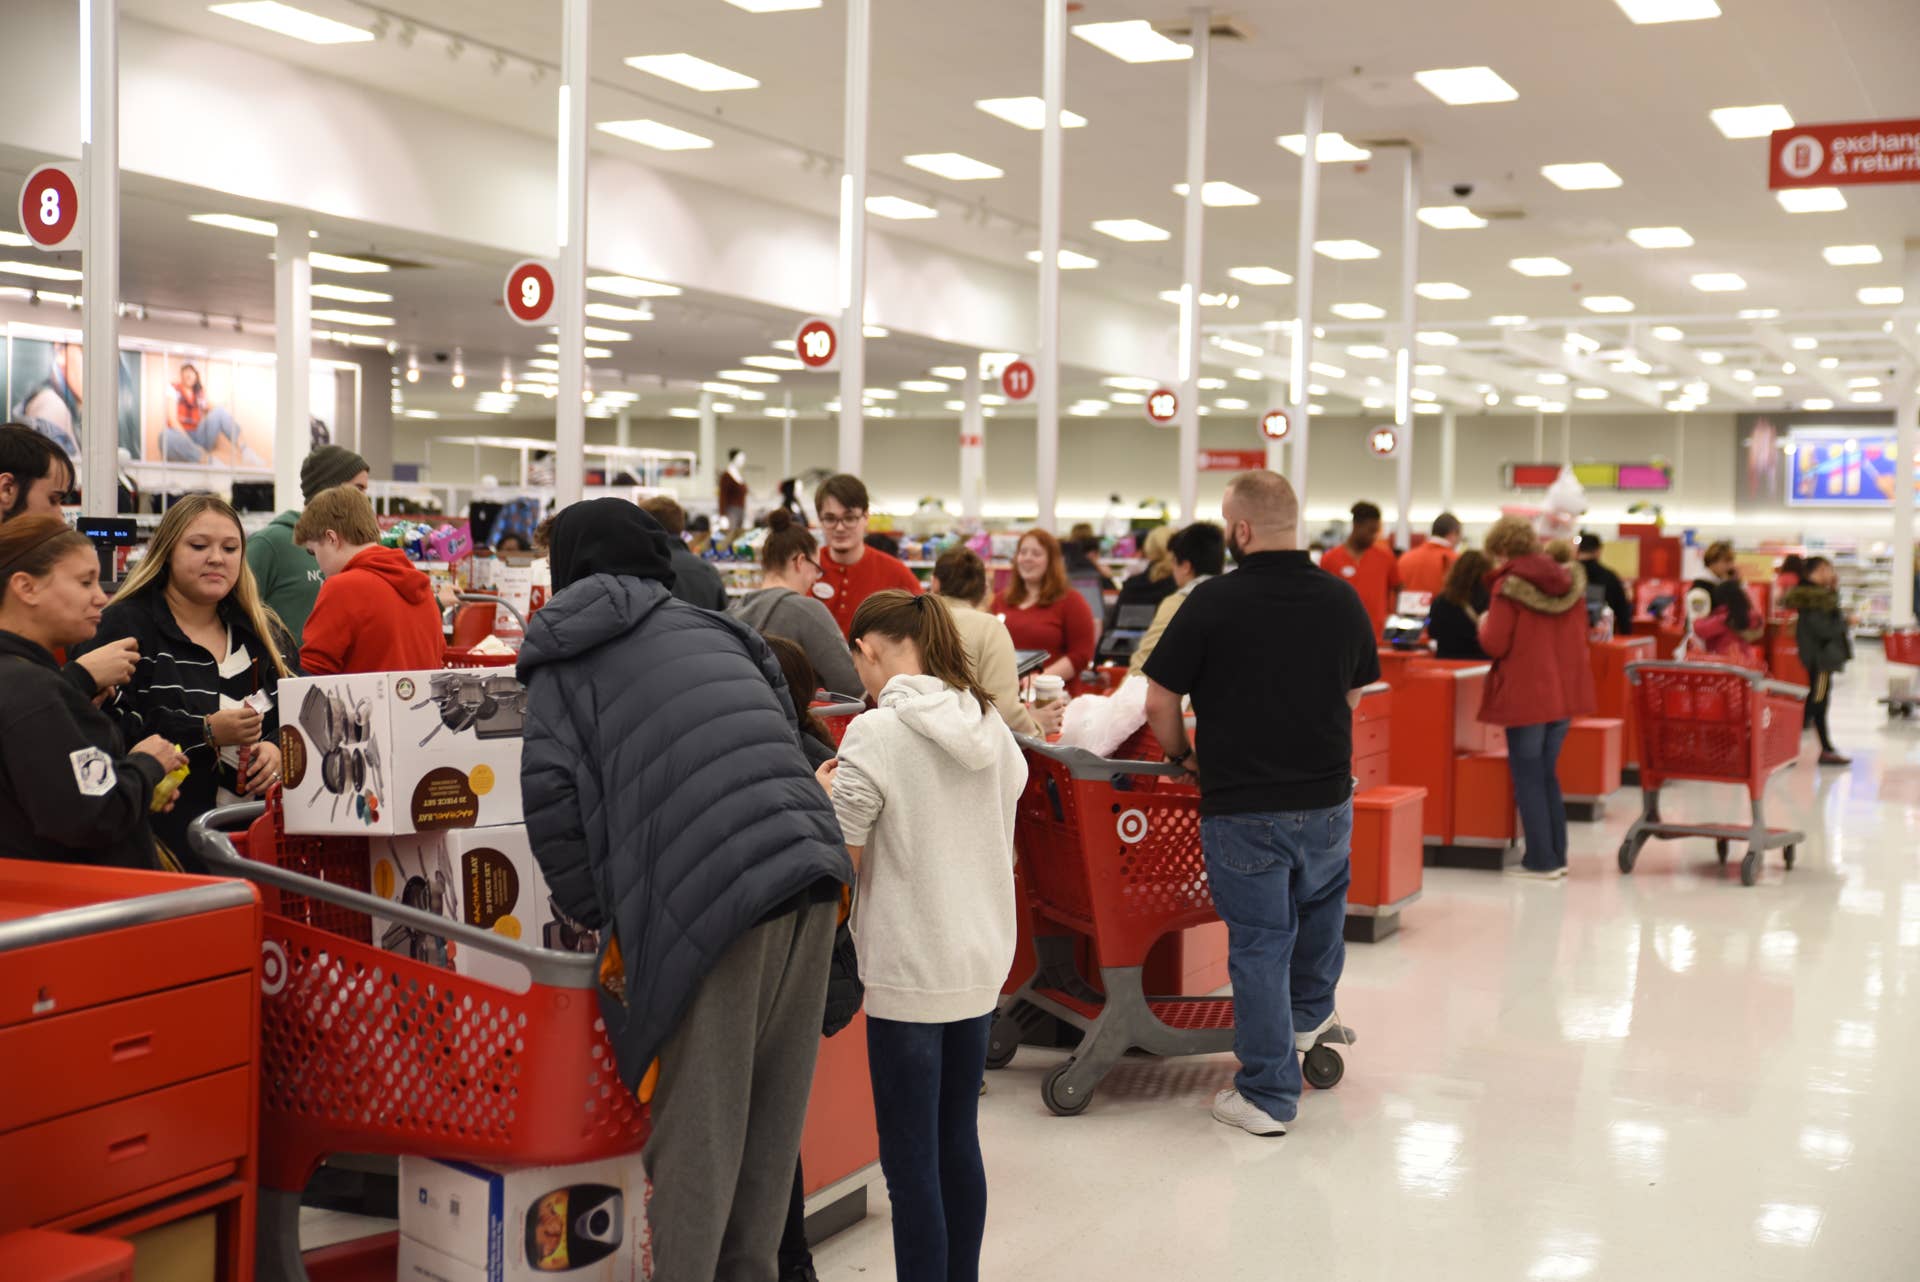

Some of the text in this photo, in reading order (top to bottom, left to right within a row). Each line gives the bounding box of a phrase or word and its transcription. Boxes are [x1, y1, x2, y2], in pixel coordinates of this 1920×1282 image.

[1829, 153, 1848, 174] &
[40, 187, 60, 226] 8
[521, 276, 540, 307] 9
[803, 331, 831, 357] 10
[1008, 370, 1029, 392] 11
[423, 799, 437, 807] SET
[438, 797, 458, 806] PIECE
[484, 861, 492, 878] SET
[484, 878, 493, 903] PIECE
